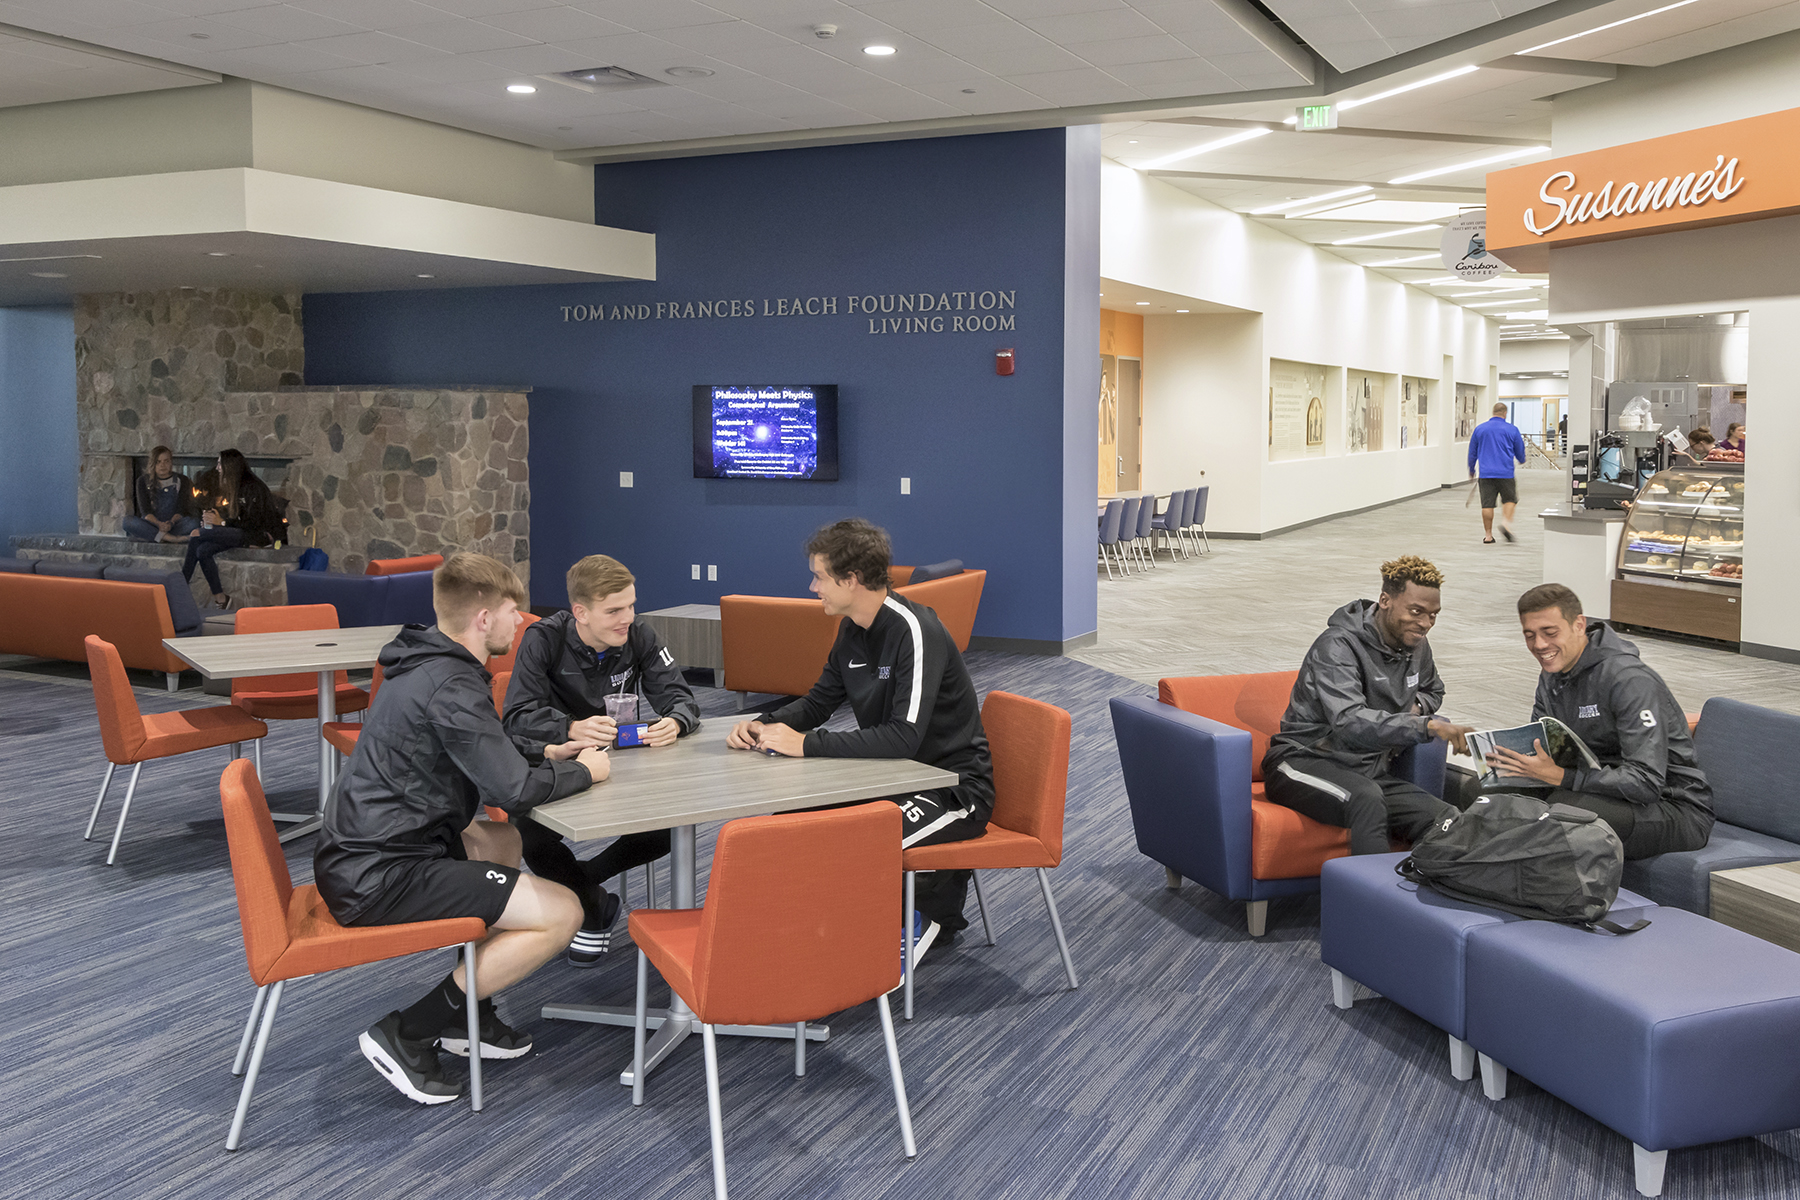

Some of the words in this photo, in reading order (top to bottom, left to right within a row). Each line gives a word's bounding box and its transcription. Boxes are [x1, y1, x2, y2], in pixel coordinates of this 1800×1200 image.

[1303, 105, 1331, 128] EXIT
[1523, 154, 1745, 236] Susanne's
[1455, 262, 1499, 270] Caribou
[560, 303, 604, 322] TOM
[609, 303, 651, 321] AND
[655, 299, 756, 320] FRANCES
[763, 297, 838, 316] LEACH
[847, 290, 1016, 314] FOUNDATION
[868, 316, 944, 334] LIVING
[952, 314, 1016, 332] ROOM
[715, 390, 757, 401] Philosophy
[758, 390, 781, 400] Meets
[1640, 709, 1657, 728] 9
[899, 800, 925, 823] 15
[485, 869, 507, 885] 3
